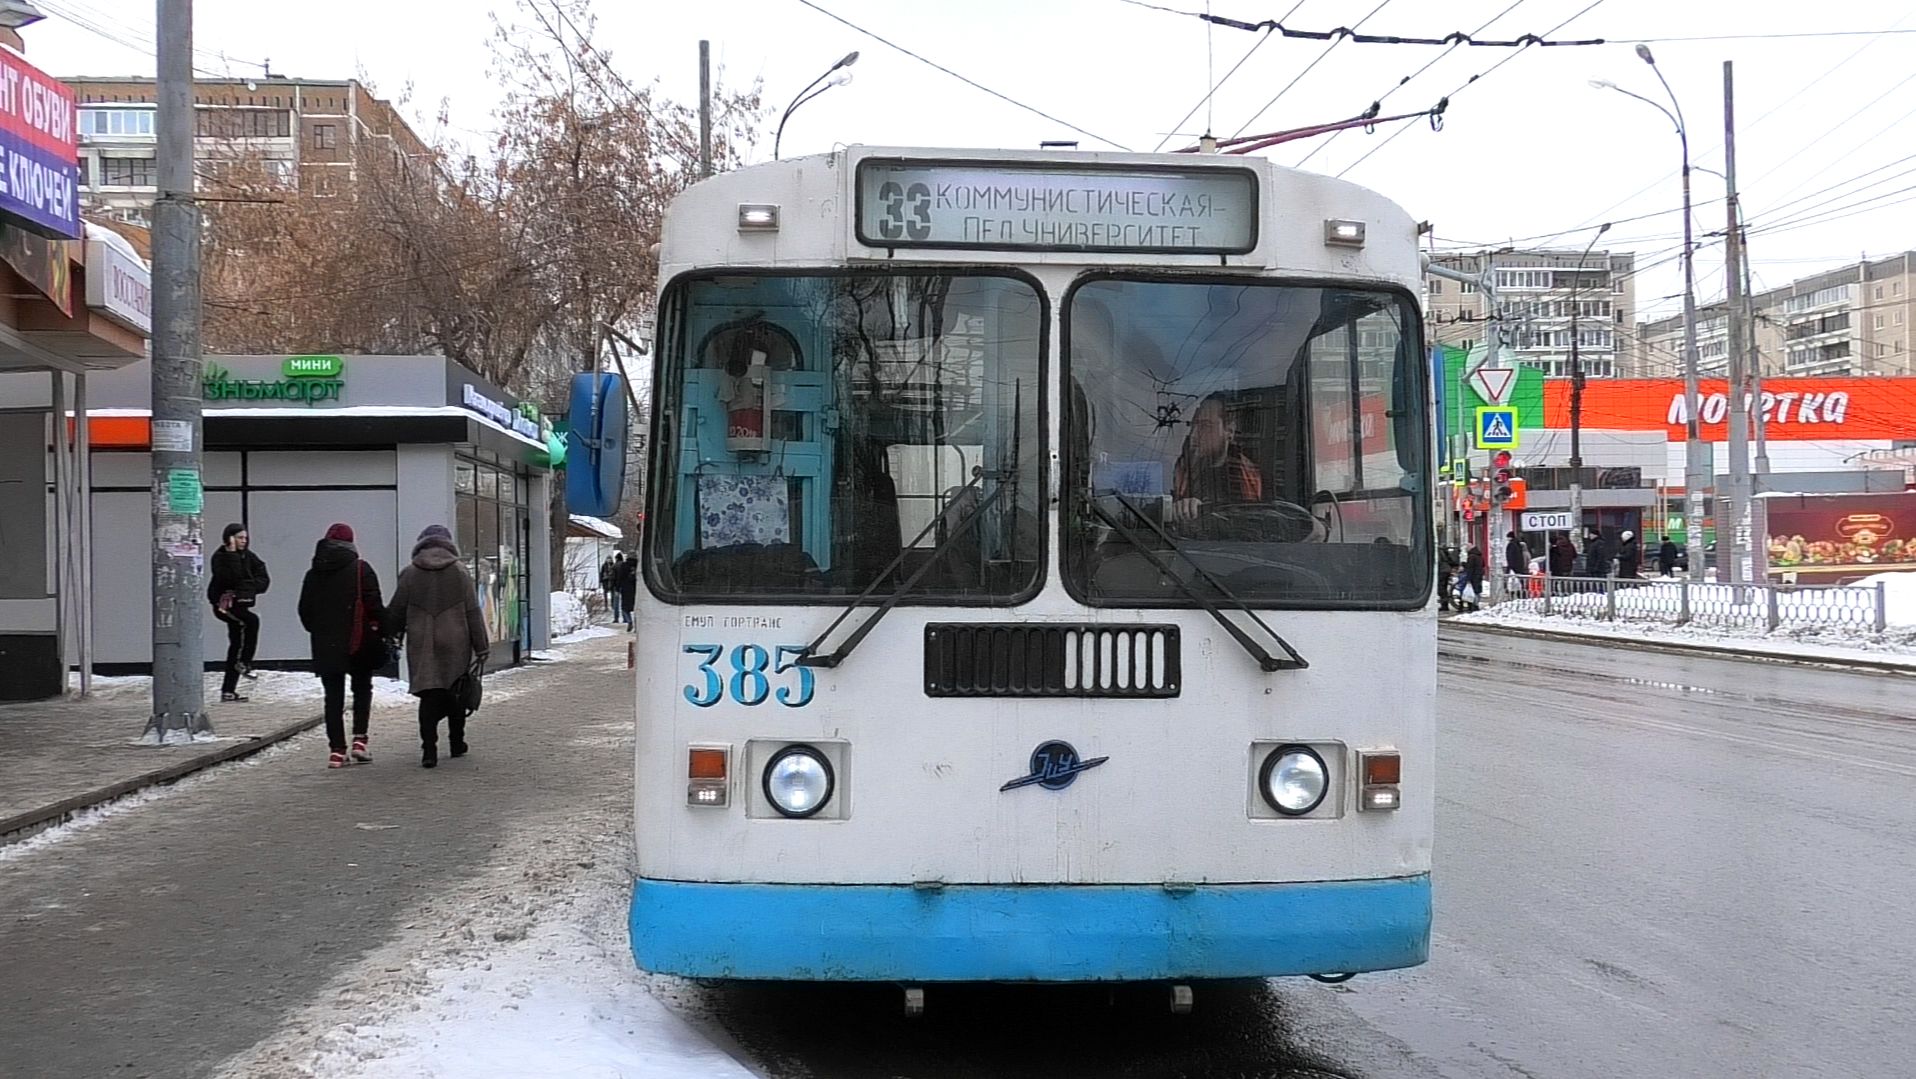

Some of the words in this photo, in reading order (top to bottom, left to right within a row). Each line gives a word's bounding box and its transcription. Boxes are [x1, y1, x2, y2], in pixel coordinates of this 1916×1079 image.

[22, 75, 72, 144] ОБУВИ
[9, 150, 72, 222] КЛЮЧЕЙ
[879, 181, 931, 240] 33
[1022, 218, 1201, 247] УНИВЕРСИТЕТ
[202, 379, 345, 407] зньмарт
[1528, 515, 1566, 528] СТОП
[685, 615, 714, 628] ЕМУП
[723, 616, 782, 629] ГОРТРАНС
[682, 644, 816, 708] 385
